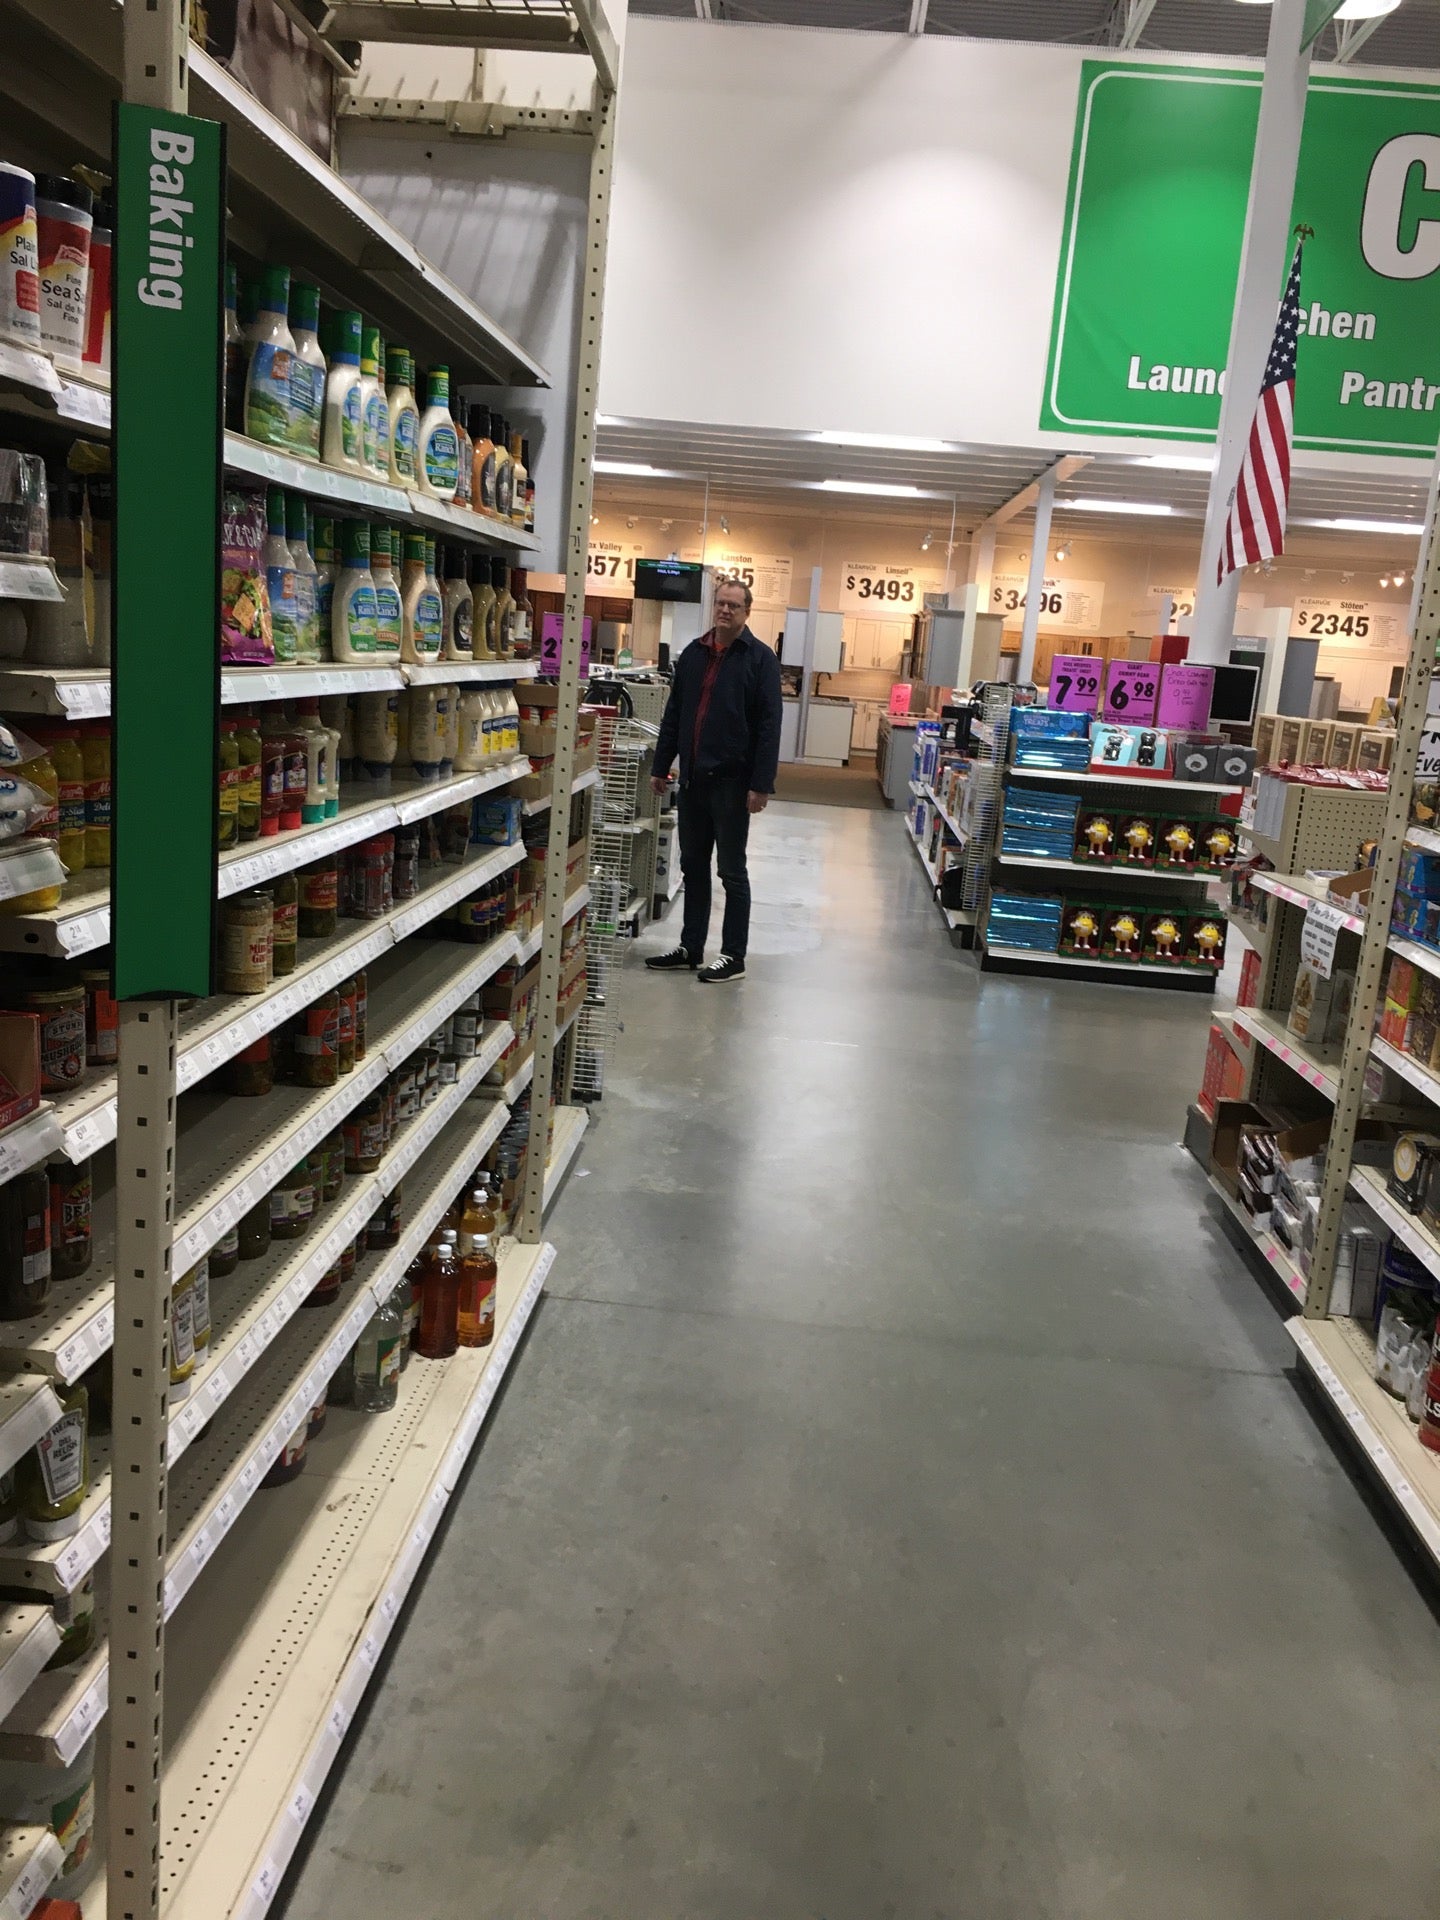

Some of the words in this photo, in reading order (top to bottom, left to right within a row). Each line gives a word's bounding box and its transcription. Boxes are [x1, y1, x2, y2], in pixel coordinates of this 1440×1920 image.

[138, 127, 195, 311] Baking
[41, 280, 71, 299] Sea
[599, 541, 623, 551] Valley
[1056, 675, 1073, 705] 7
[1076, 676, 1098, 693] 99
[1110, 679, 1129, 710] 6
[1133, 681, 1155, 698] 98
